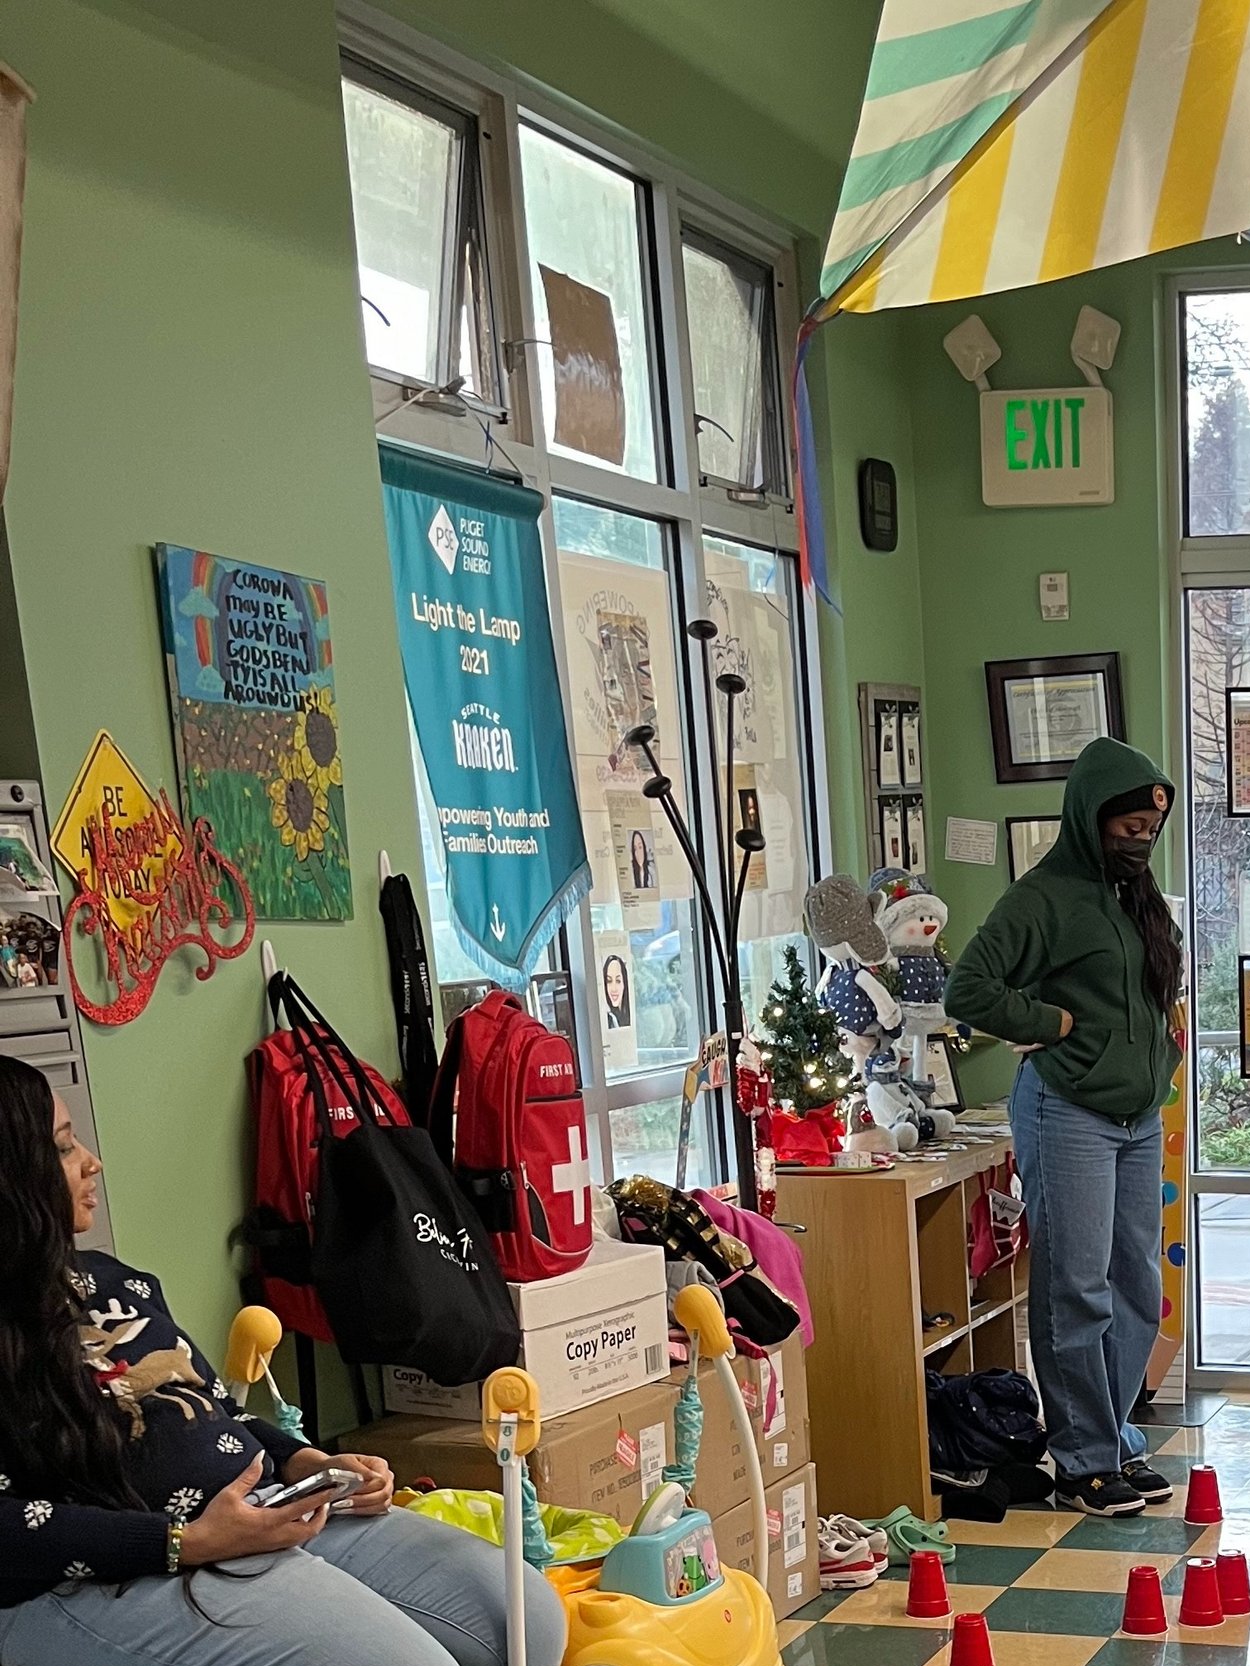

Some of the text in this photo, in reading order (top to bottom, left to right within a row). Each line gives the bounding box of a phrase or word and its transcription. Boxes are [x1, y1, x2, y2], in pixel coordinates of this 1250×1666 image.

[1006, 398, 1085, 470] EXIT
[435, 526, 454, 551] PSE
[460, 518, 485, 538] PUGET
[461, 537, 489, 557] SOUND
[232, 568, 294, 601] CORONA
[263, 603, 289, 622] BE
[411, 592, 521, 647] Light the Lamp
[229, 618, 309, 656] UGLY BUT
[225, 639, 271, 669] GODS
[460, 644, 490, 675] 2021
[223, 680, 292, 709] AROUND
[269, 672, 300, 693] ALL
[460, 702, 501, 725] SEATTLE
[103, 785, 128, 817] BE
[493, 806, 528, 829] Youth
[529, 808, 550, 828] and
[487, 834, 539, 855] Outreach
[701, 1037, 727, 1065] CAUGH
[540, 1063, 563, 1078] FIRST
[328, 1106, 355, 1120] IRS
[566, 1325, 637, 1361] Copy Paper
[394, 1368, 424, 1385] Copy
